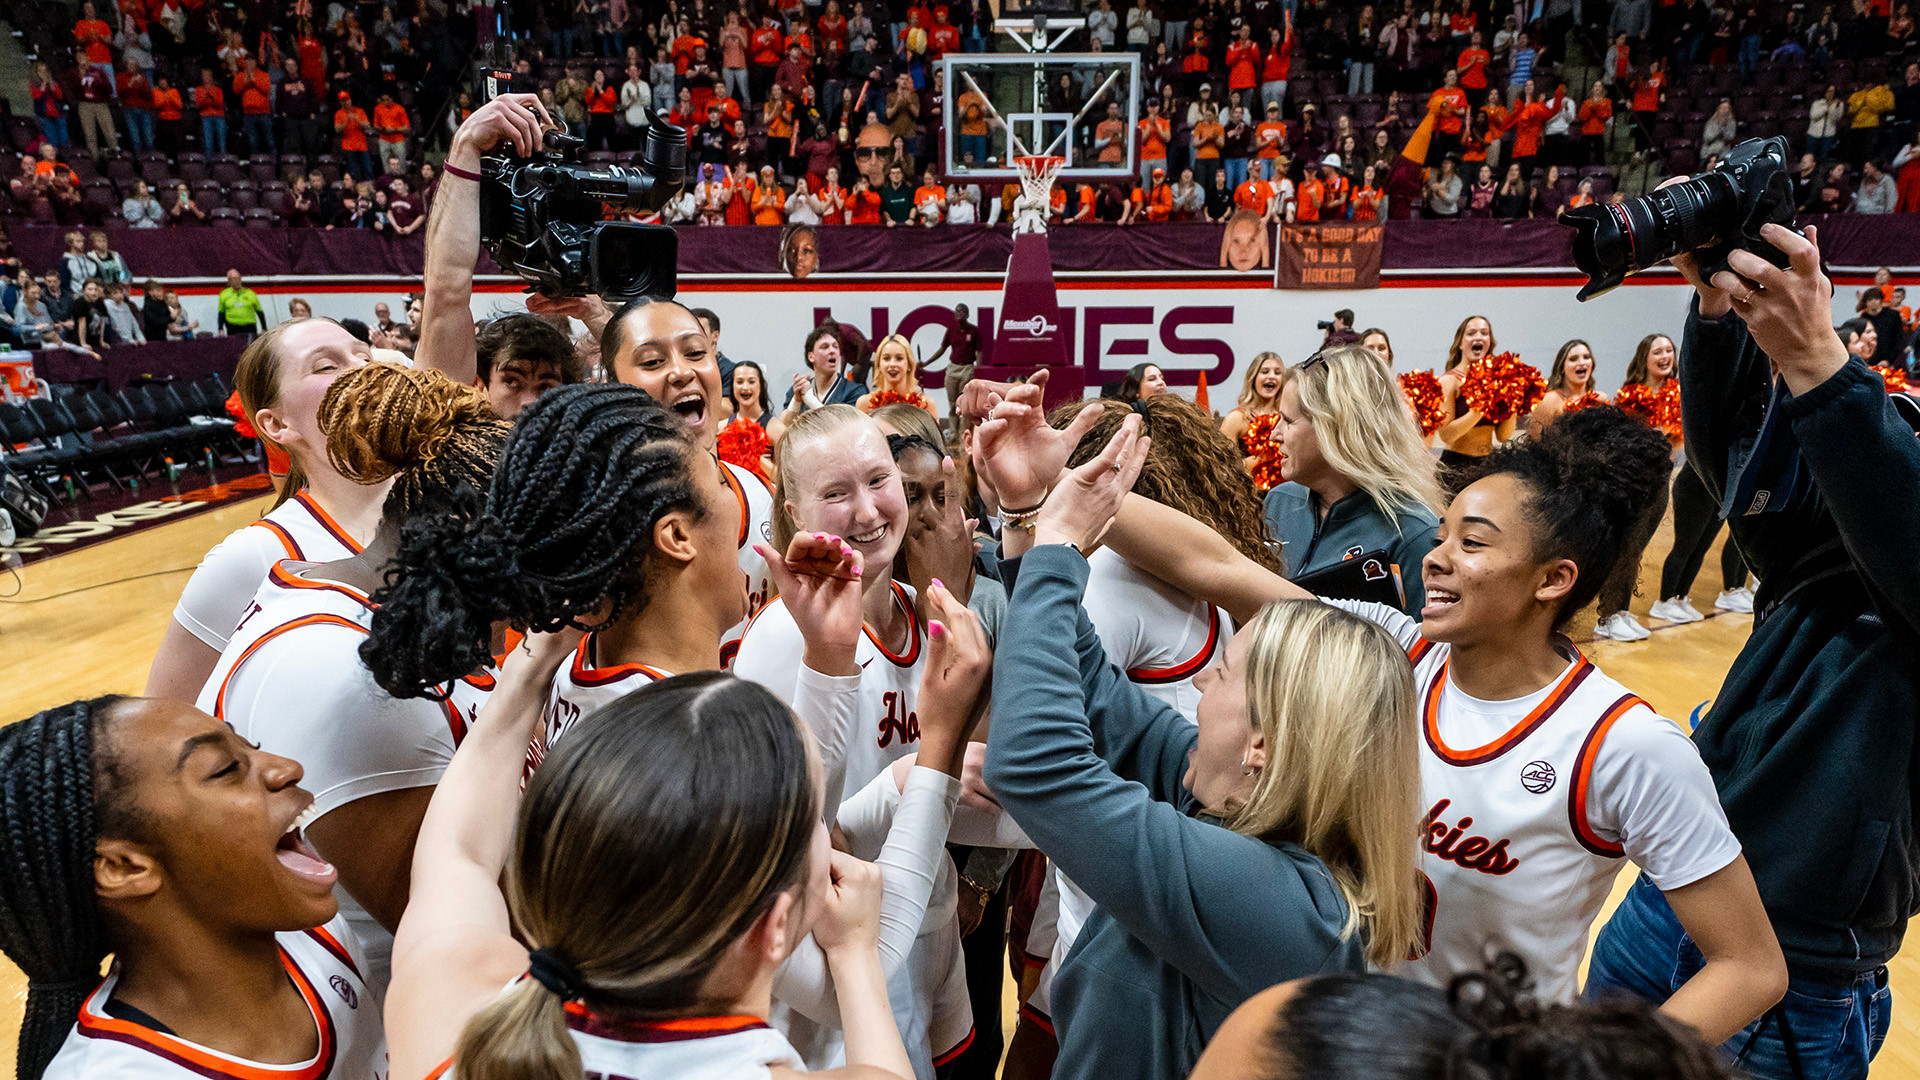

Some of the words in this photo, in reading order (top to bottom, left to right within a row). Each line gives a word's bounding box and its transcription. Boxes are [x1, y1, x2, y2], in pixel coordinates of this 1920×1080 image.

[1308, 227, 1318, 243] A
[1321, 227, 1354, 243] GOOD
[1356, 227, 1382, 243] DAY
[1303, 248, 1319, 263] TO
[1321, 248, 1338, 263] BE
[1342, 248, 1352, 263] A
[813, 305, 1236, 389] HOIES
[877, 690, 921, 749] Ho
[1524, 770, 1556, 782] ACC
